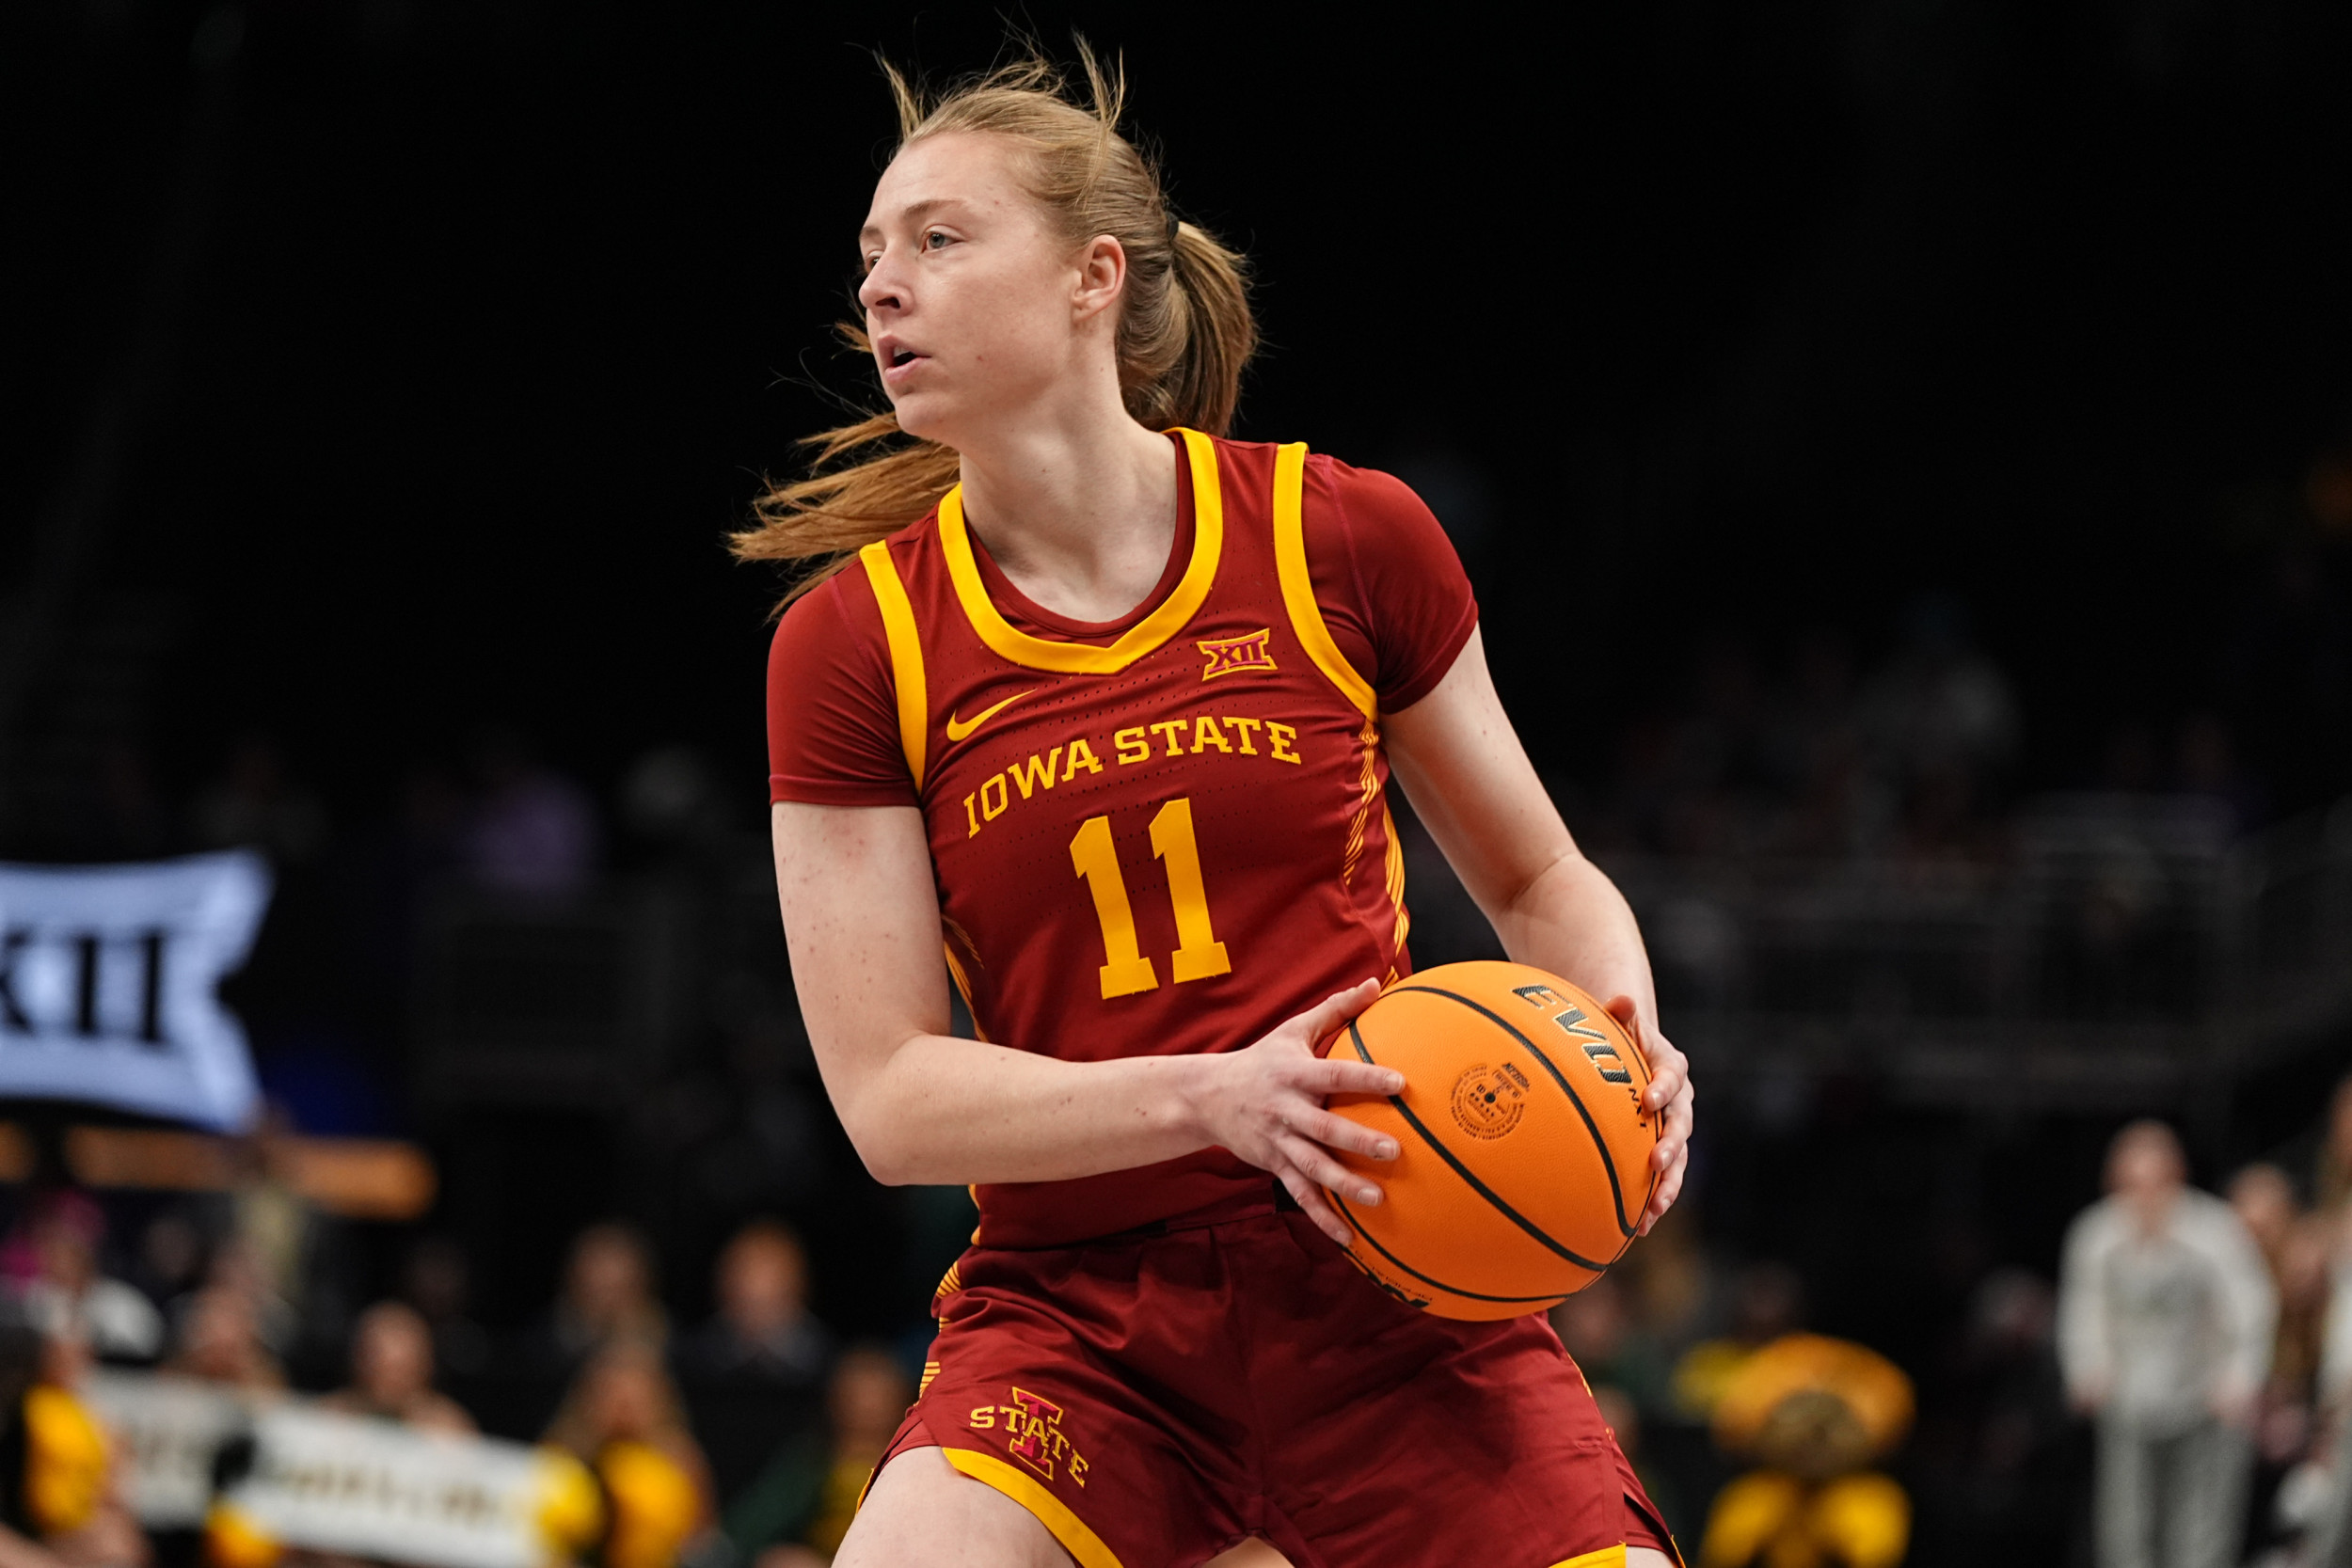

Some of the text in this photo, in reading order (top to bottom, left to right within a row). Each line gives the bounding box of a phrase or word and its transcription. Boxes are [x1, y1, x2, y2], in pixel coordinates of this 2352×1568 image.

[1203, 635, 1271, 674] XII
[963, 716, 1302, 839] IOWA STATE
[1069, 797, 1232, 1000] 11
[1511, 984, 1634, 1085] EVO
[970, 1405, 1089, 1488] STATE
